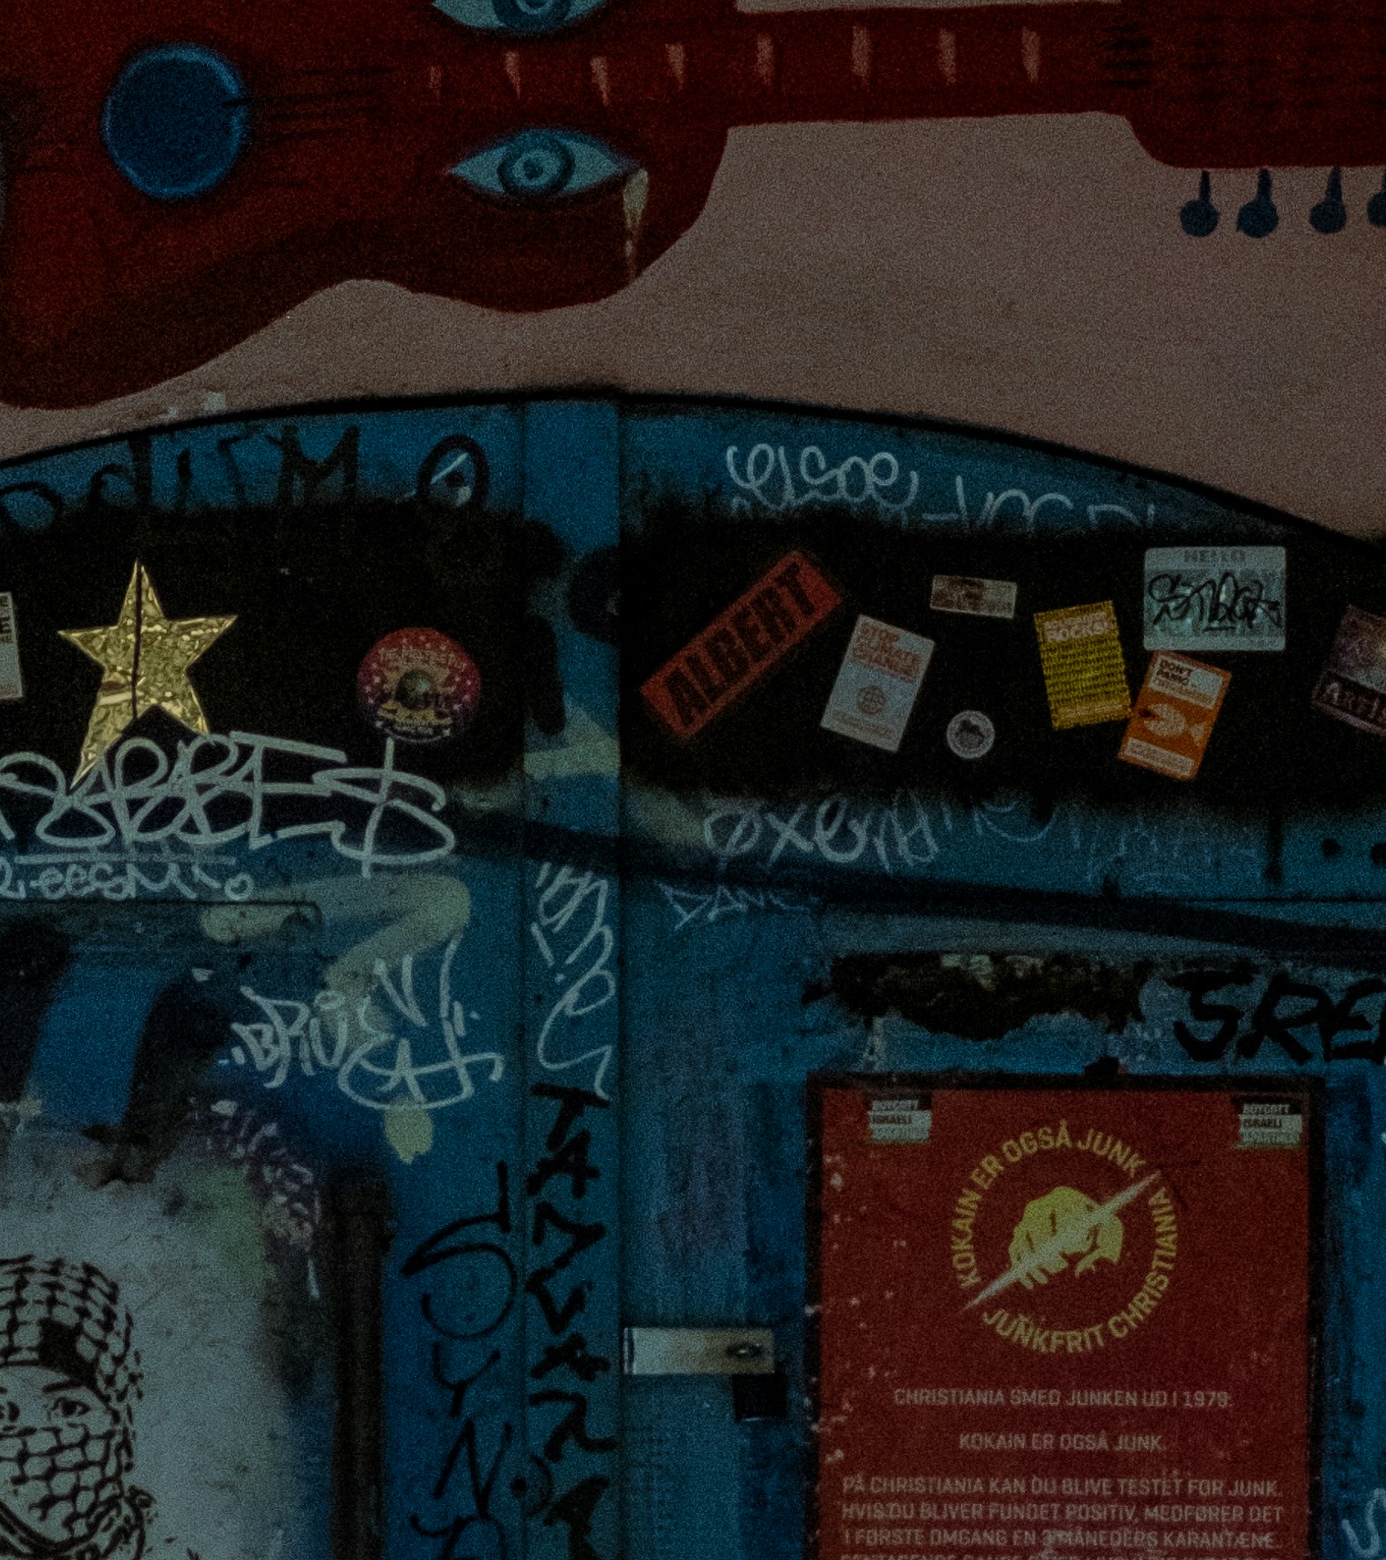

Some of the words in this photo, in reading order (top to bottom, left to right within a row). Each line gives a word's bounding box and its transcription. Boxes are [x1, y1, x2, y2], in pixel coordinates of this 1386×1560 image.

[663, 560, 816, 728] ALBERT
[951, 1188, 983, 1288] KOKAIN
[969, 1154, 1006, 1190] ER
[1001, 1118, 1073, 1164] OGSÅ
[1076, 1127, 1148, 1178] JUNK
[981, 1309, 1106, 1354] JUNKFRIT
[1107, 1186, 1179, 1339] CHRISTIANIA
[893, 1388, 1005, 1406] CHRISTIANIA
[1009, 1389, 1062, 1406] SMED
[1065, 1390, 1137, 1407] JUNKEN
[1141, 1391, 1168, 1407] UD
[1172, 1391, 1177, 1407] I
[958, 1432, 1027, 1451] KOKAIN
[1031, 1433, 1055, 1451] ER
[1059, 1428, 1109, 1452] OGSÅ
[1112, 1434, 1167, 1453] JUNK.
[842, 1472, 864, 1494] PÅ
[869, 1476, 984, 1494] CHRISTIANIA
[989, 1477, 1025, 1494] KAN
[1031, 1476, 1058, 1495] DU
[1062, 1477, 1113, 1496] BLIVE
[1117, 1477, 1183, 1496] TESTET
[1187, 1478, 1225, 1496] FOR
[1228, 1479, 1283, 1497] JUNK.
[842, 1502, 886, 1520] HVIS
[889, 1502, 915, 1520] DU
[919, 1502, 984, 1520] BLIVER
[988, 1503, 1059, 1521] FUNDET
[1065, 1504, 1140, 1524] POSITIV,
[1144, 1504, 1244, 1523] MEDFØRER
[1248, 1506, 1284, 1523] DET
[854, 1527, 925, 1546] FØRSTE
[929, 1528, 1008, 1547] OMGANG
[1013, 1529, 1037, 1546] EN
[1056, 1526, 1159, 1548] MÅNEDERS
